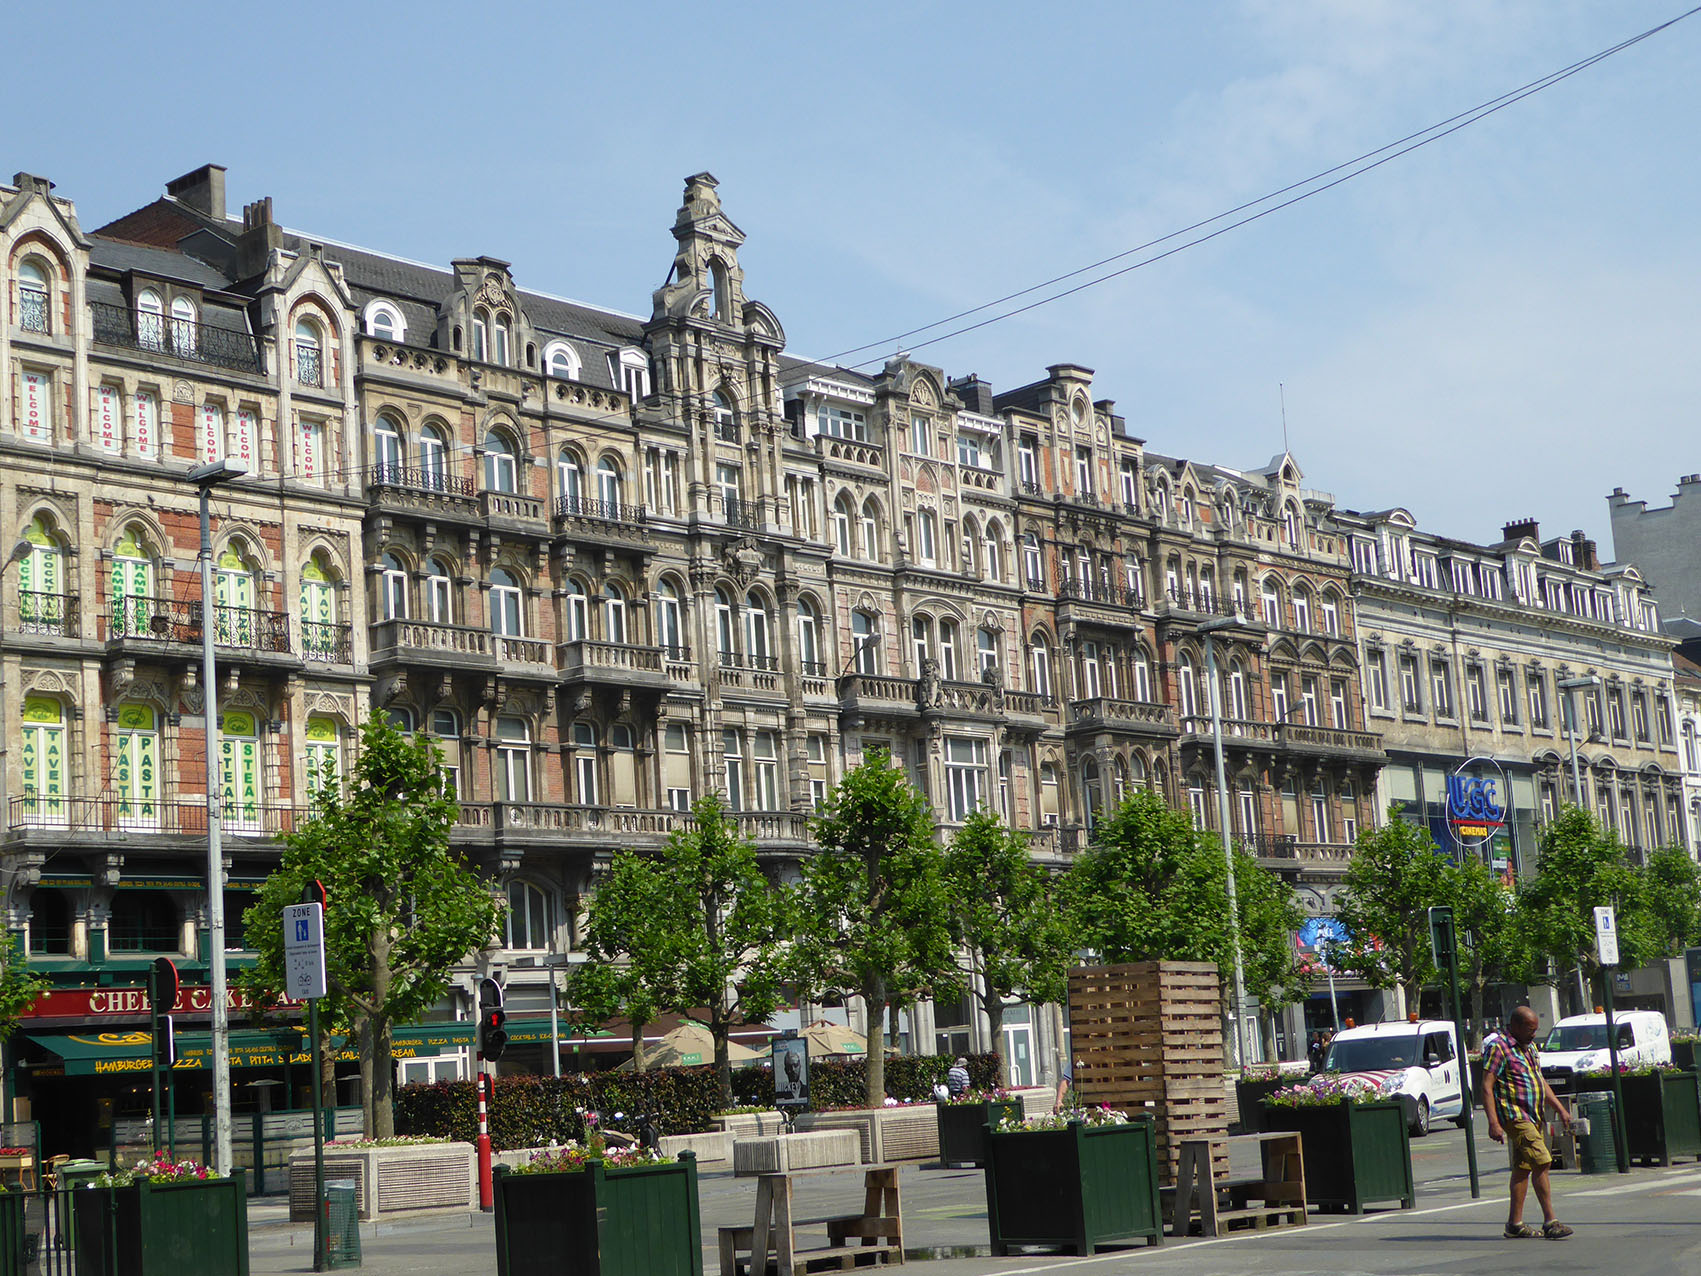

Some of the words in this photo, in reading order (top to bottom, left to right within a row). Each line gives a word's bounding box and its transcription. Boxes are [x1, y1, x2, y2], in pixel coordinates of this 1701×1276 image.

[26, 375, 39, 436] WELCOME
[100, 387, 113, 447] WELCOME
[136, 394, 148, 452] WELCOME
[204, 406, 217, 463] WELCOME
[238, 411, 250, 464] WELCOM
[302, 424, 314, 479] WELCOME
[23, 730, 35, 808] TAVERN
[48, 732, 59, 808] TAVERN
[118, 737, 130, 813] PASTA
[141, 738, 153, 815] PASTA
[222, 743, 234, 812] STEAK
[243, 745, 255, 813] STEAK
[1447, 775, 1500, 820] UGC
[293, 908, 311, 918] ZONE
[89, 991, 184, 1013] CHEEE
[95, 1059, 153, 1074] HAMBURGER
[172, 1058, 203, 1069] ZZA
[278, 1053, 313, 1064] SLADS
